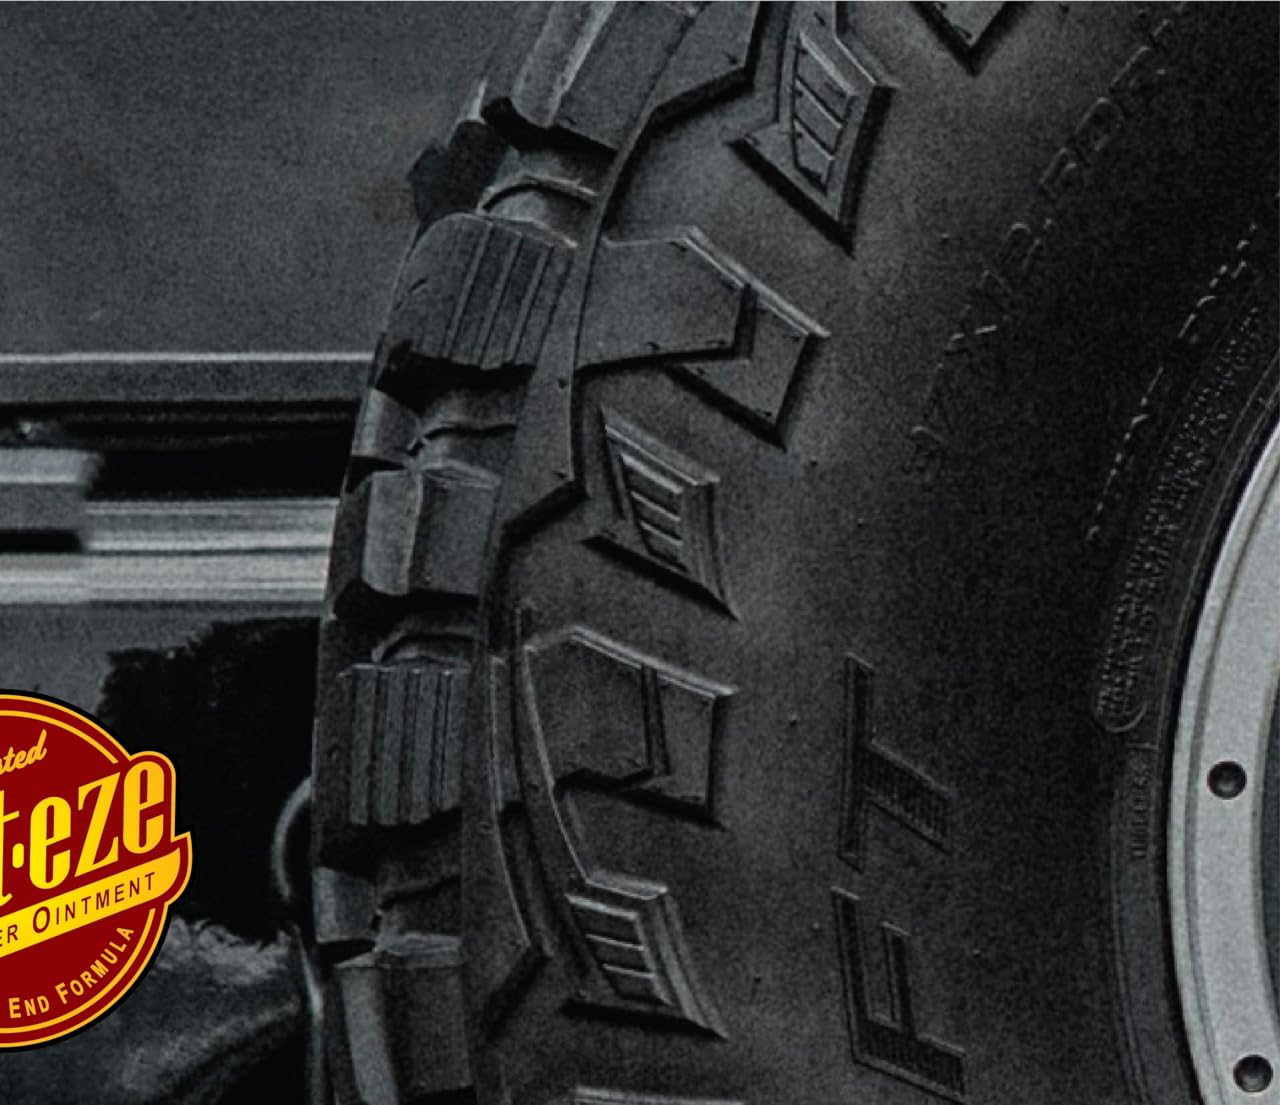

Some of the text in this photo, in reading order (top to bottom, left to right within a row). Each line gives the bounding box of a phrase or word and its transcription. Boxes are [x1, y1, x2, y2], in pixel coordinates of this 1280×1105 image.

[32, 871, 156, 934] OINTMENT
[9, 994, 51, 1019] END
[55, 925, 135, 1005] FORMULA
